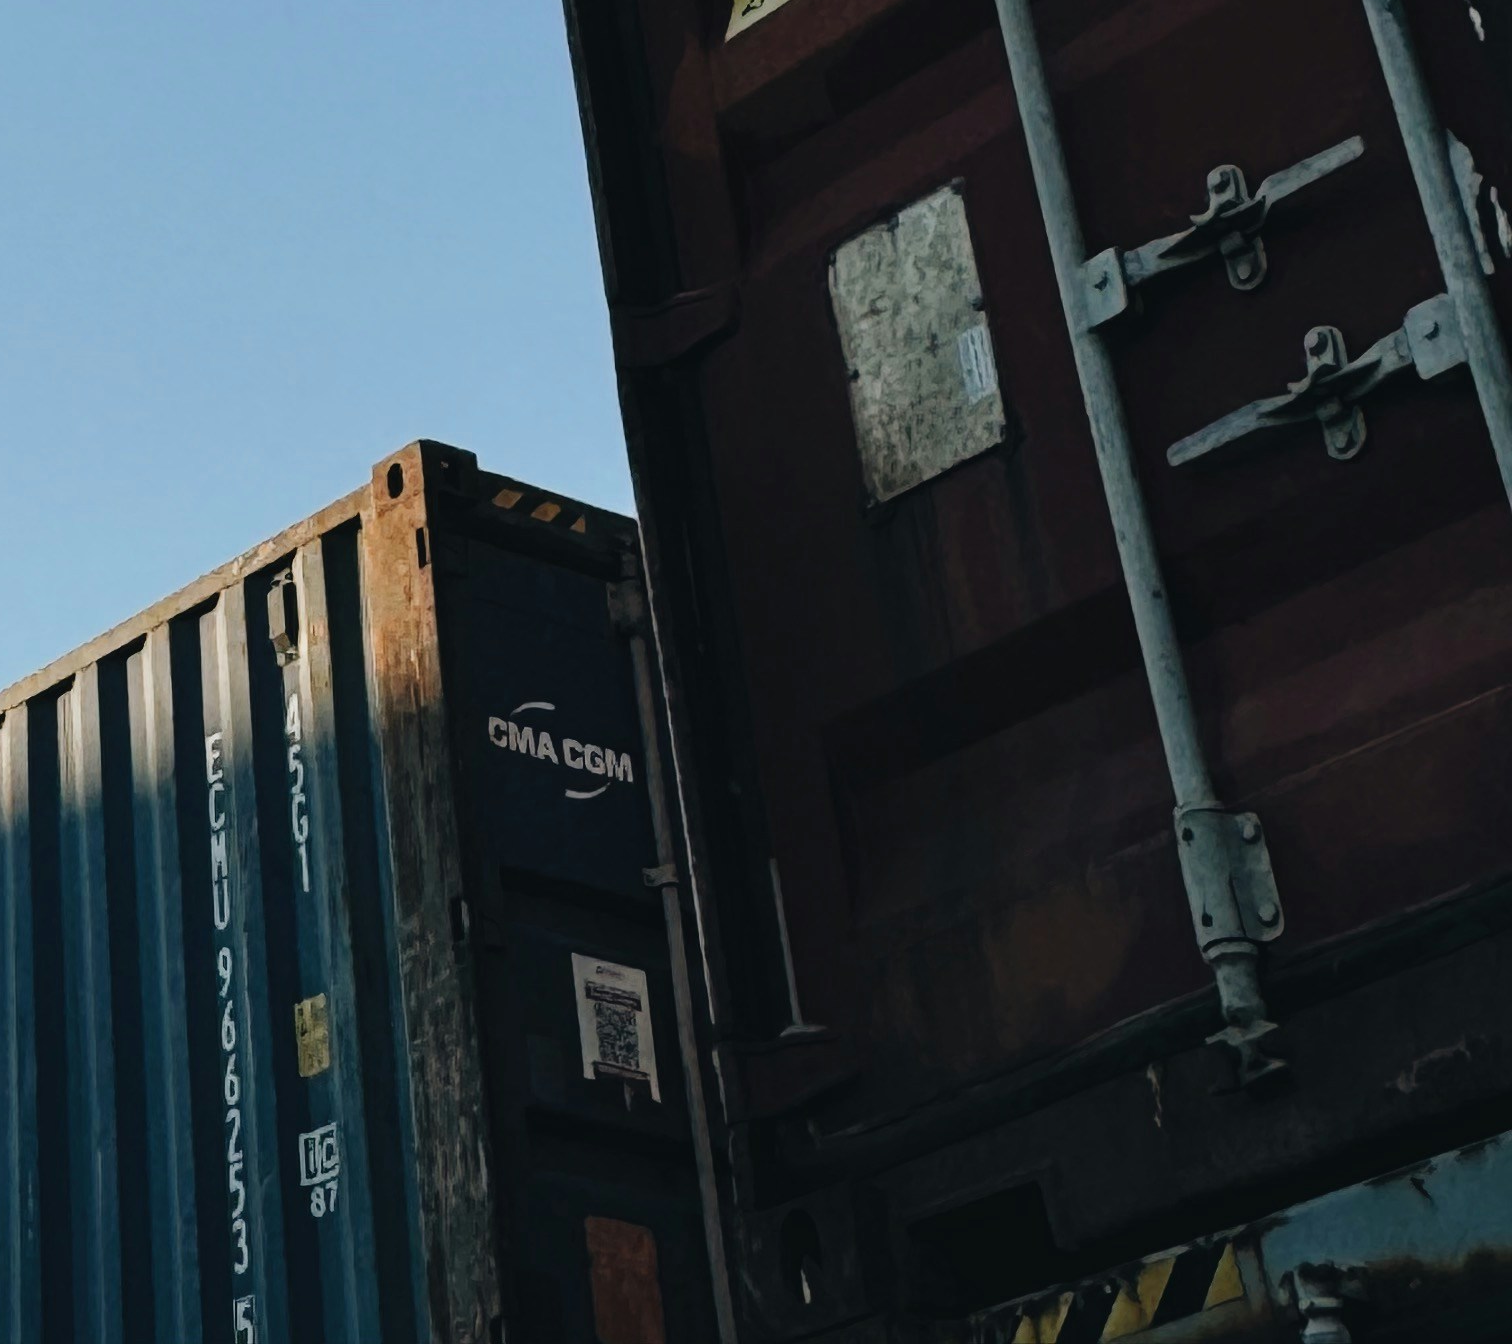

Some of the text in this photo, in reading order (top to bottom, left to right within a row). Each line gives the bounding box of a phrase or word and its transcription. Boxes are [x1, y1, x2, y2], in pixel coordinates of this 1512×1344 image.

[487, 715, 634, 783] CMA CGM
[205, 731, 231, 931] ECMU
